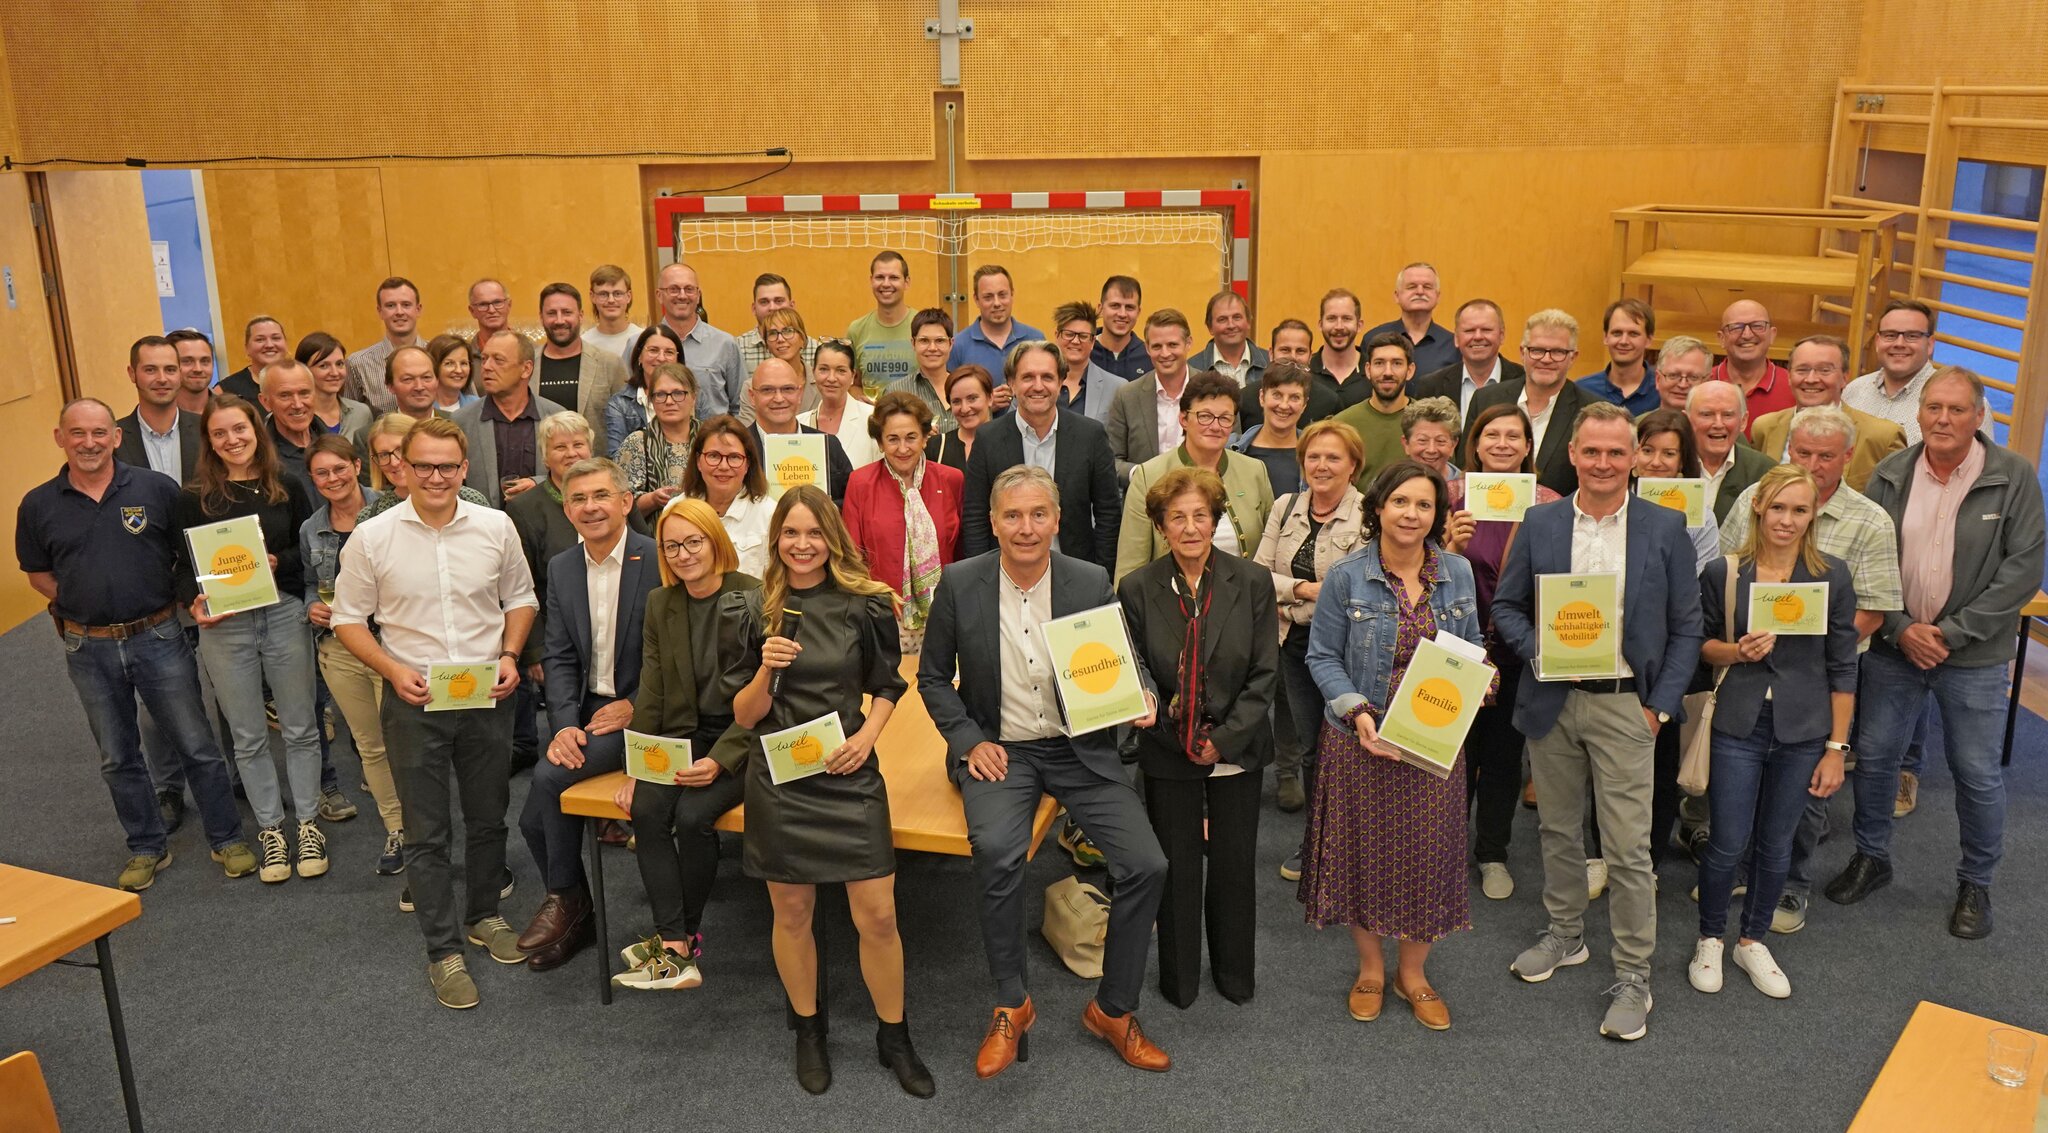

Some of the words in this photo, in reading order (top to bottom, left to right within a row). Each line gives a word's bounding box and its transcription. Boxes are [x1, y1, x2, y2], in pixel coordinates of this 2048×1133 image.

[772, 463, 810, 472] Wohnen
[811, 463, 819, 471] &
[783, 472, 810, 480] Leben
[1470, 479, 1506, 491] weil
[1641, 484, 1680, 497] weil
[217, 553, 247, 567] Junge
[208, 560, 261, 576] Gemeinde
[1753, 589, 1796, 603] weil
[1557, 609, 1601, 621] Umwelt
[1547, 621, 1610, 632] Nachhaltigkeit
[1559, 632, 1598, 641] Mobilität
[430, 667, 471, 681] weil
[1062, 655, 1128, 680] Gesundheit
[1416, 688, 1458, 714] Familie
[628, 740, 661, 754] weil
[768, 730, 808, 752] weil
